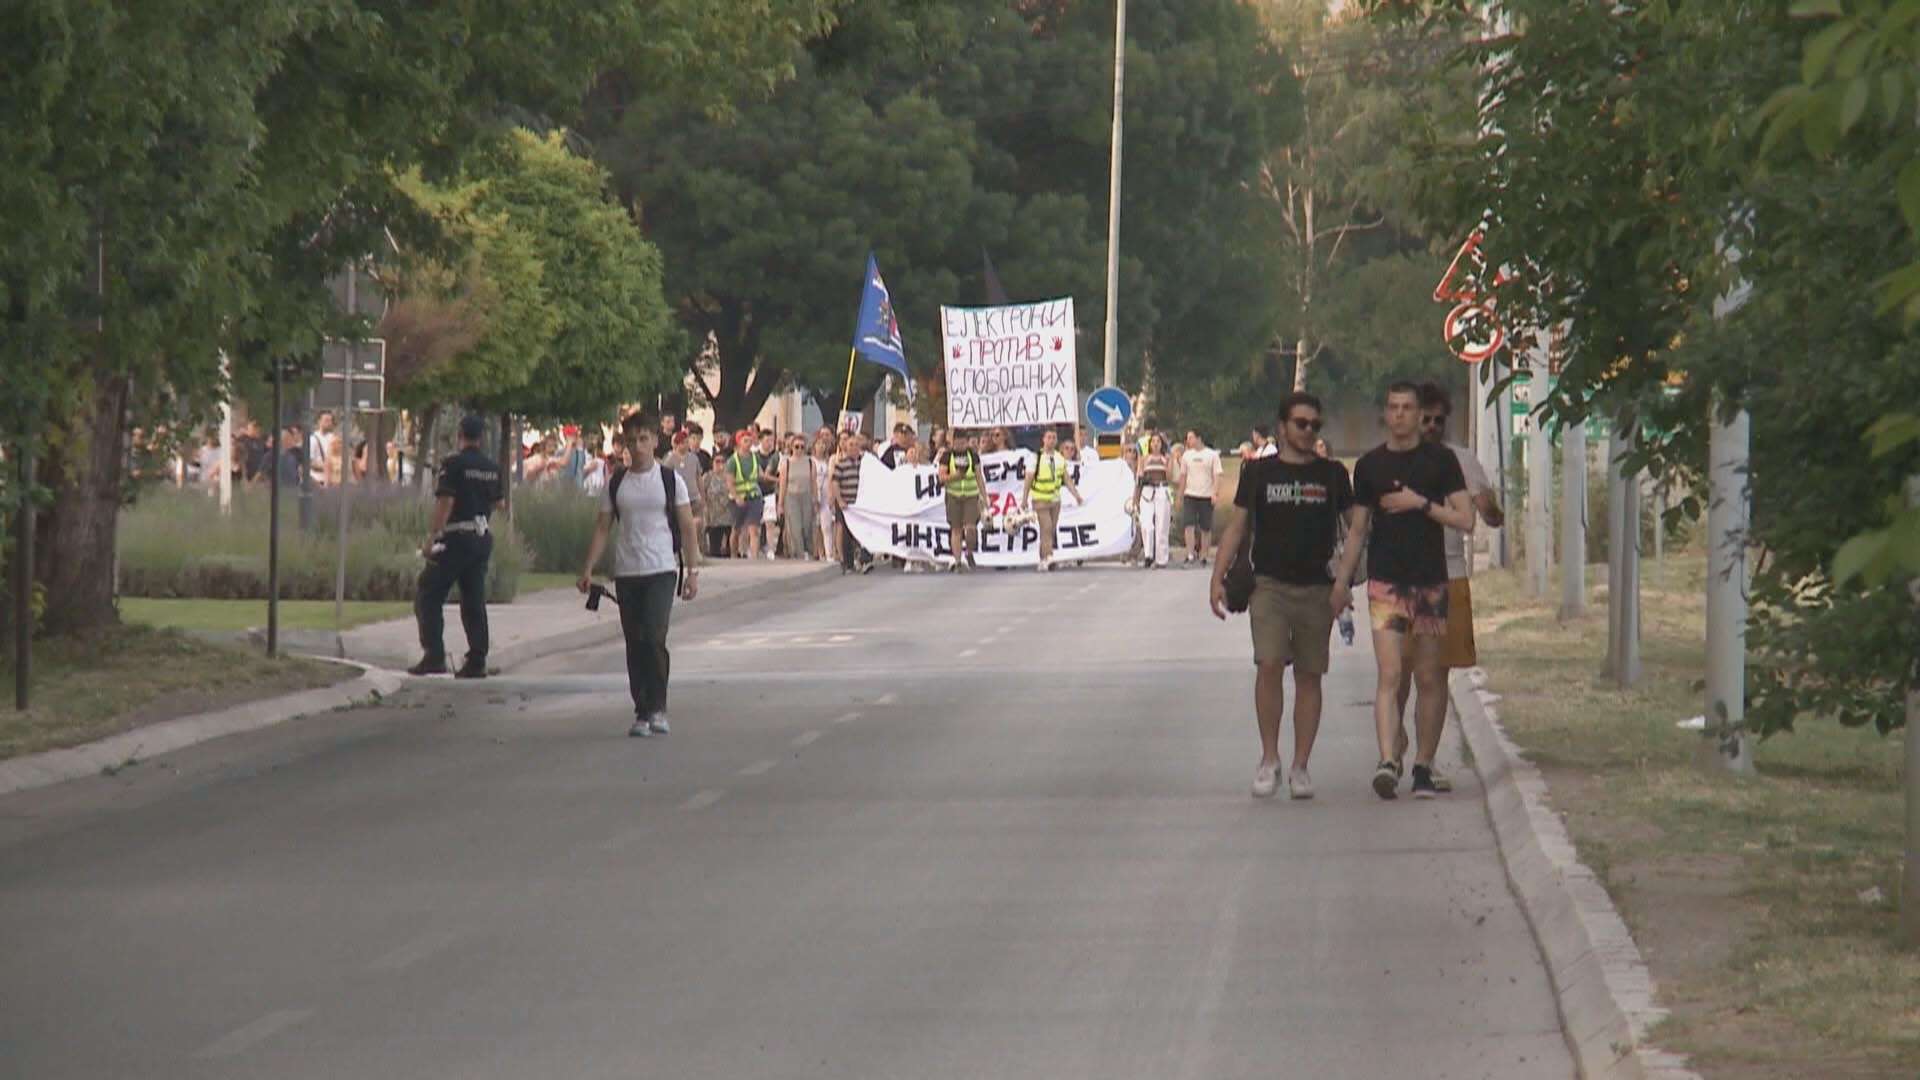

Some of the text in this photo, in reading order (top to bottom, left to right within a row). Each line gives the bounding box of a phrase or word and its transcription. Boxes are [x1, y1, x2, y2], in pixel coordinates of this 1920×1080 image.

[969, 332, 1044, 366] ПРОТИВ
[950, 362, 1067, 395] СЛОБОДНИХ
[951, 393, 1068, 425] РАДИКАЛА
[987, 491, 1020, 516] ЗА
